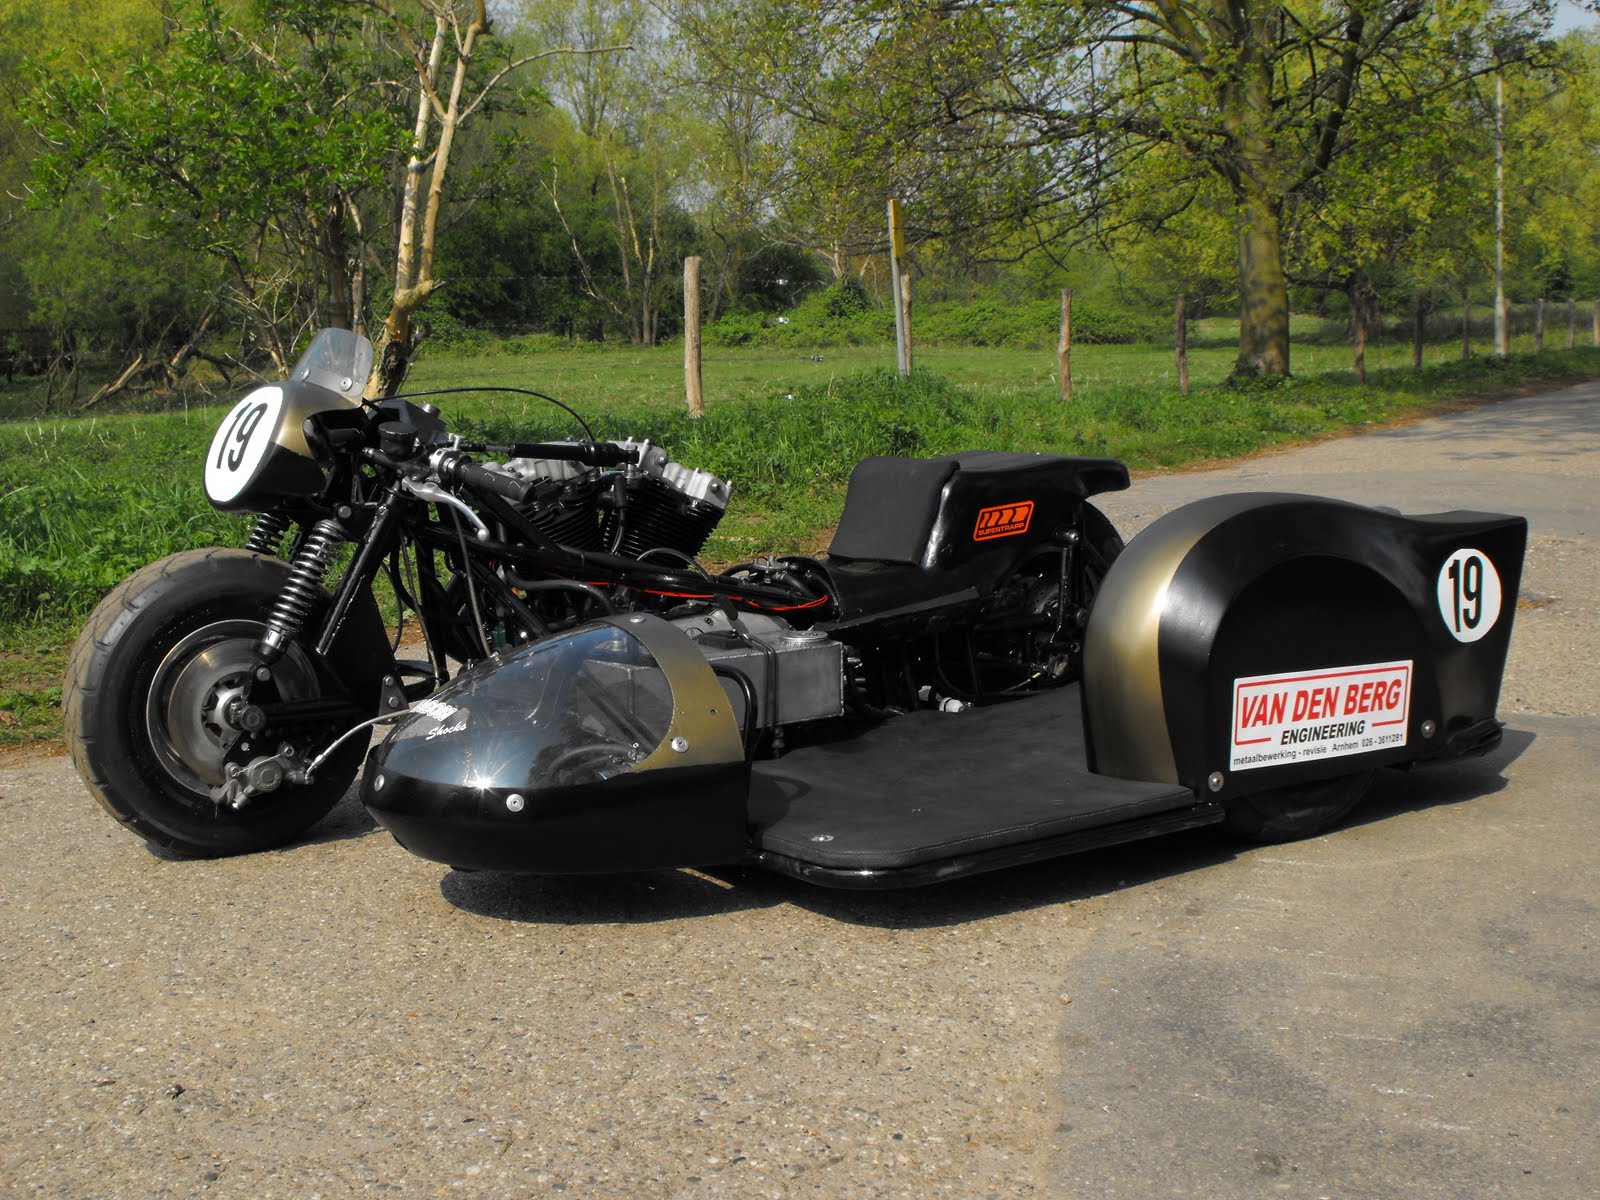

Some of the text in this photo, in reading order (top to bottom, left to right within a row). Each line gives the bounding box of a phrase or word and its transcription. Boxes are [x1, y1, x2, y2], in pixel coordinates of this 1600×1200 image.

[216, 402, 268, 472] 19
[978, 522, 1025, 536] SUPERTRAPP
[1448, 555, 1483, 633] 19
[1241, 678, 1402, 729] VAN DEN BERG
[425, 720, 468, 741] Shocks
[1280, 720, 1366, 746] ENGINEERING
[1233, 749, 1297, 766] metaalbewerking
[1302, 745, 1327, 756] revisie
[1332, 740, 1359, 752] Arnhem
[1361, 738, 1373, 748] 026
